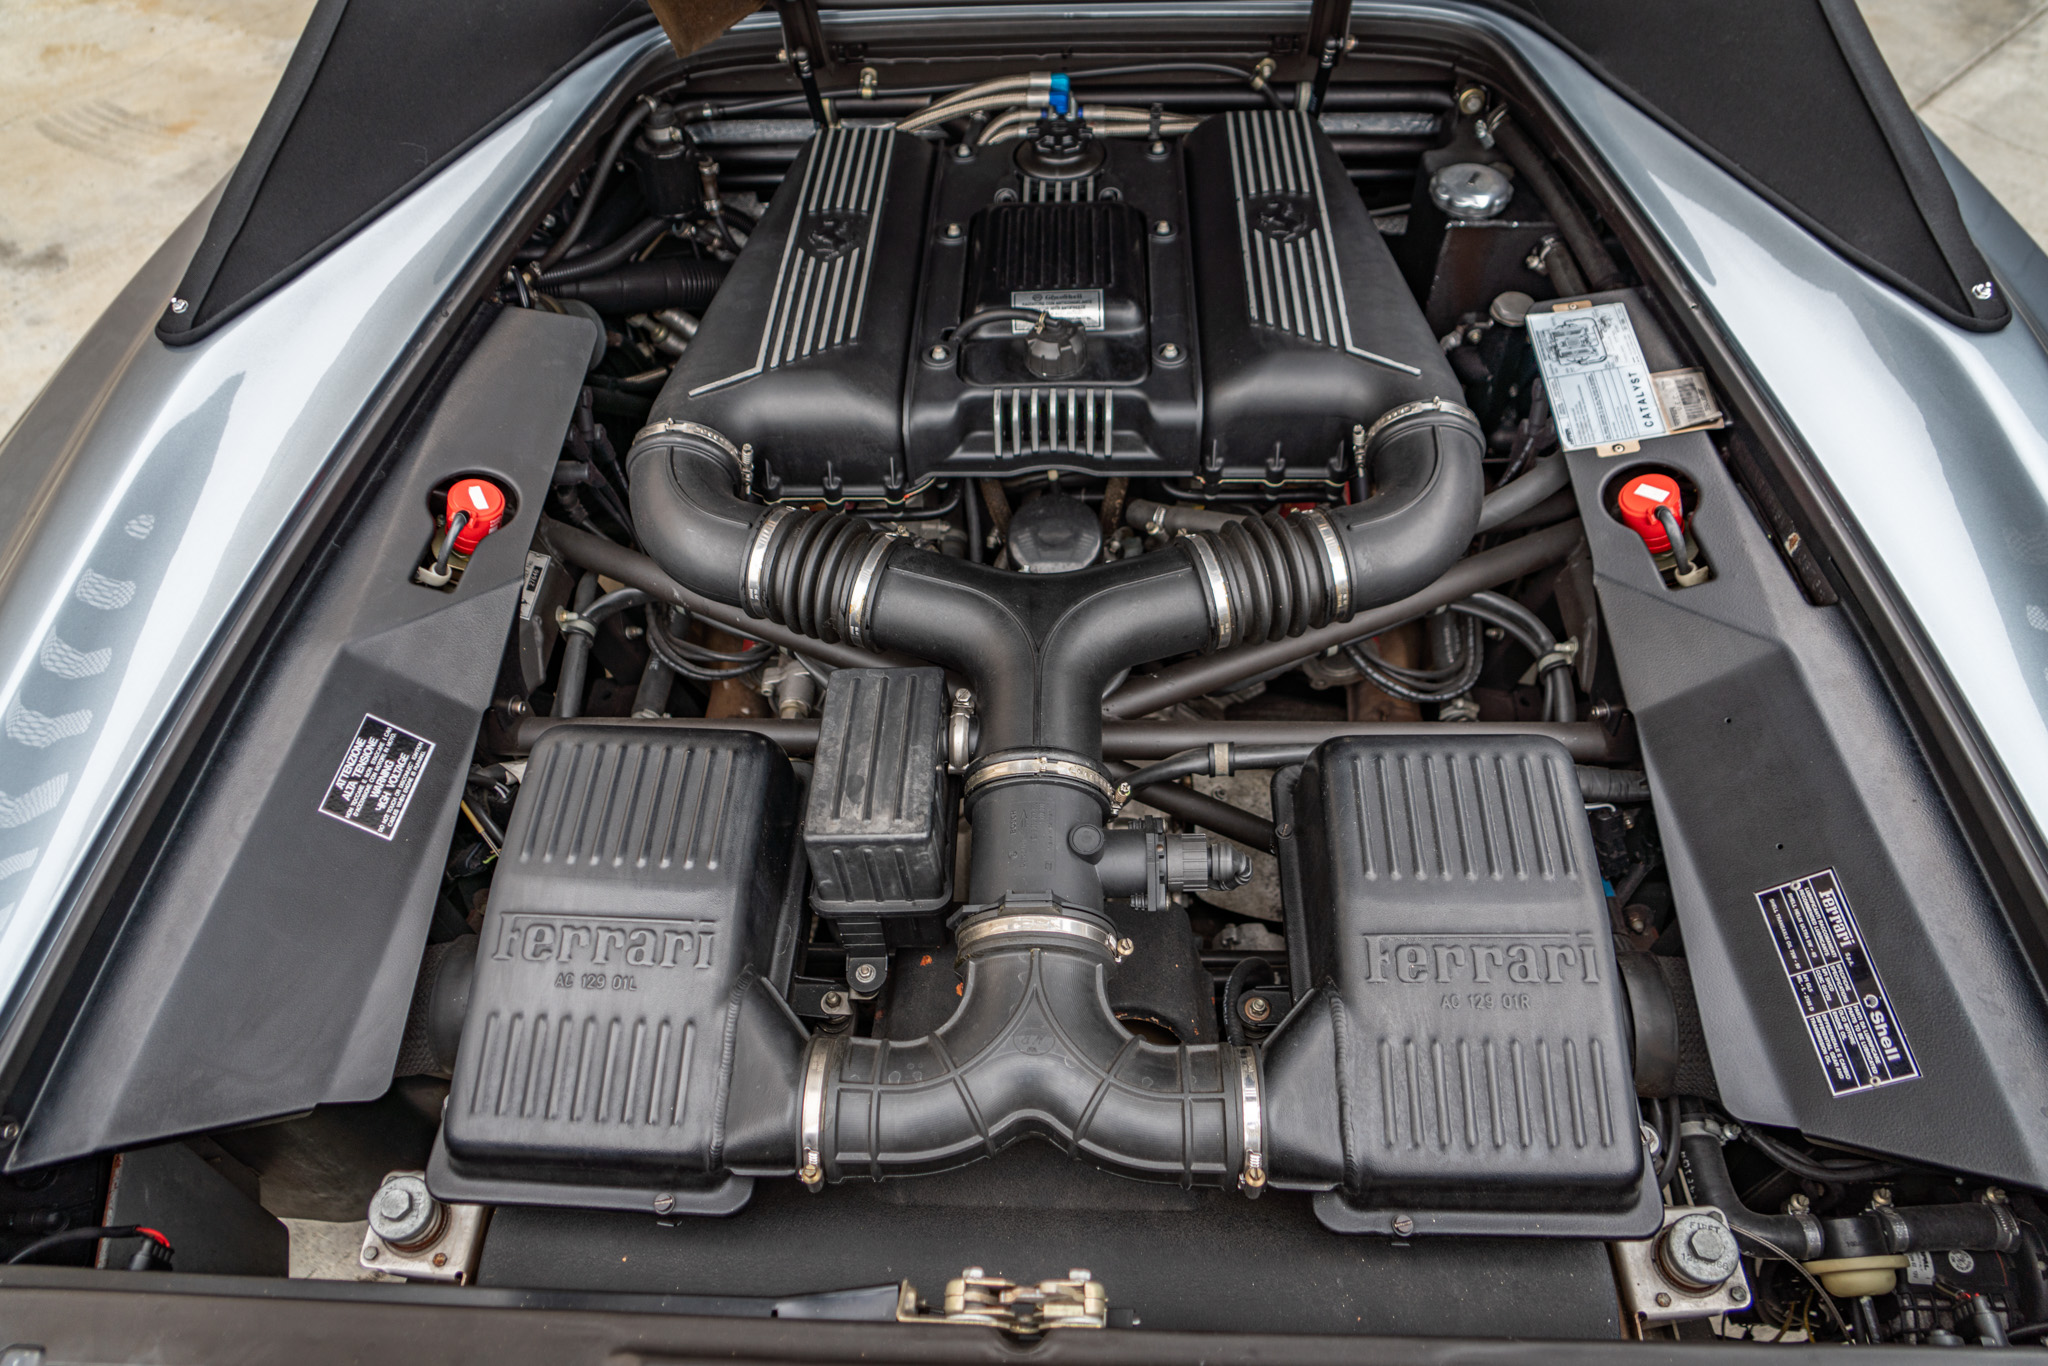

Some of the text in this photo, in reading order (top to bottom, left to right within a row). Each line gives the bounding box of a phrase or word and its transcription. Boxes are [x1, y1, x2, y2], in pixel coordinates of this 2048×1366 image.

[1628, 372, 1654, 427] CATALYST
[335, 737, 366, 790] ATTENZIONE
[342, 736, 378, 801] ALTA TENSIONE
[368, 772, 377, 783] CON
[374, 753, 387, 771] MOTORE
[369, 760, 394, 798] WARNING
[386, 752, 409, 788] VOLTAGE
[345, 807, 354, 819] NON
[350, 784, 365, 806] TOCCARE
[364, 766, 373, 778] NON
[377, 824, 385, 833] DO
[381, 813, 390, 824] NOT
[386, 797, 397, 813] TOUCH
[387, 809, 399, 827] CABLES
[396, 793, 406, 807] WHEN
[402, 777, 414, 793] ENGINE
[492, 912, 717, 969] Ferrari
[1769, 898, 1778, 913] SHELL
[1775, 913, 1790, 940] TRANSAXLE
[1787, 892, 1797, 908] SHELL
[1794, 908, 1803, 923] HELIX
[1799, 923, 1810, 939] ULTRA
[1797, 889, 1830, 956] RECOMMENDED LUBRICANTS
[1804, 887, 1837, 958] LUBRIFICANTI RACCOMANDATI
[1818, 888, 1855, 947] Ferrari
[554, 972, 638, 991] AC 129 01L
[1362, 932, 1600, 984] Ferrari
[1836, 963, 1851, 991] SPECIFICHE
[1440, 994, 1532, 1010] AC 129 01R
[1830, 964, 1849, 1003] SPECIFICATIONS
[1810, 1016, 1828, 1055] TRANSMISSION
[1832, 1010, 1843, 1030] ENGINE
[1838, 1009, 1856, 1045] OLIO MOTORE
[1847, 1006, 1878, 1074] PARTS TO BE LUBRICATED
[1853, 1004, 1881, 1064] PARTI DA LUBRIFICARE
[1870, 1010, 1900, 1061] Shell
[1815, 1015, 1844, 1079] DIFFERENTIAL GEAR AND
[1821, 1013, 1840, 1053] DIFFERENZIALE
[1839, 1058, 1851, 1079] CAMBIO
